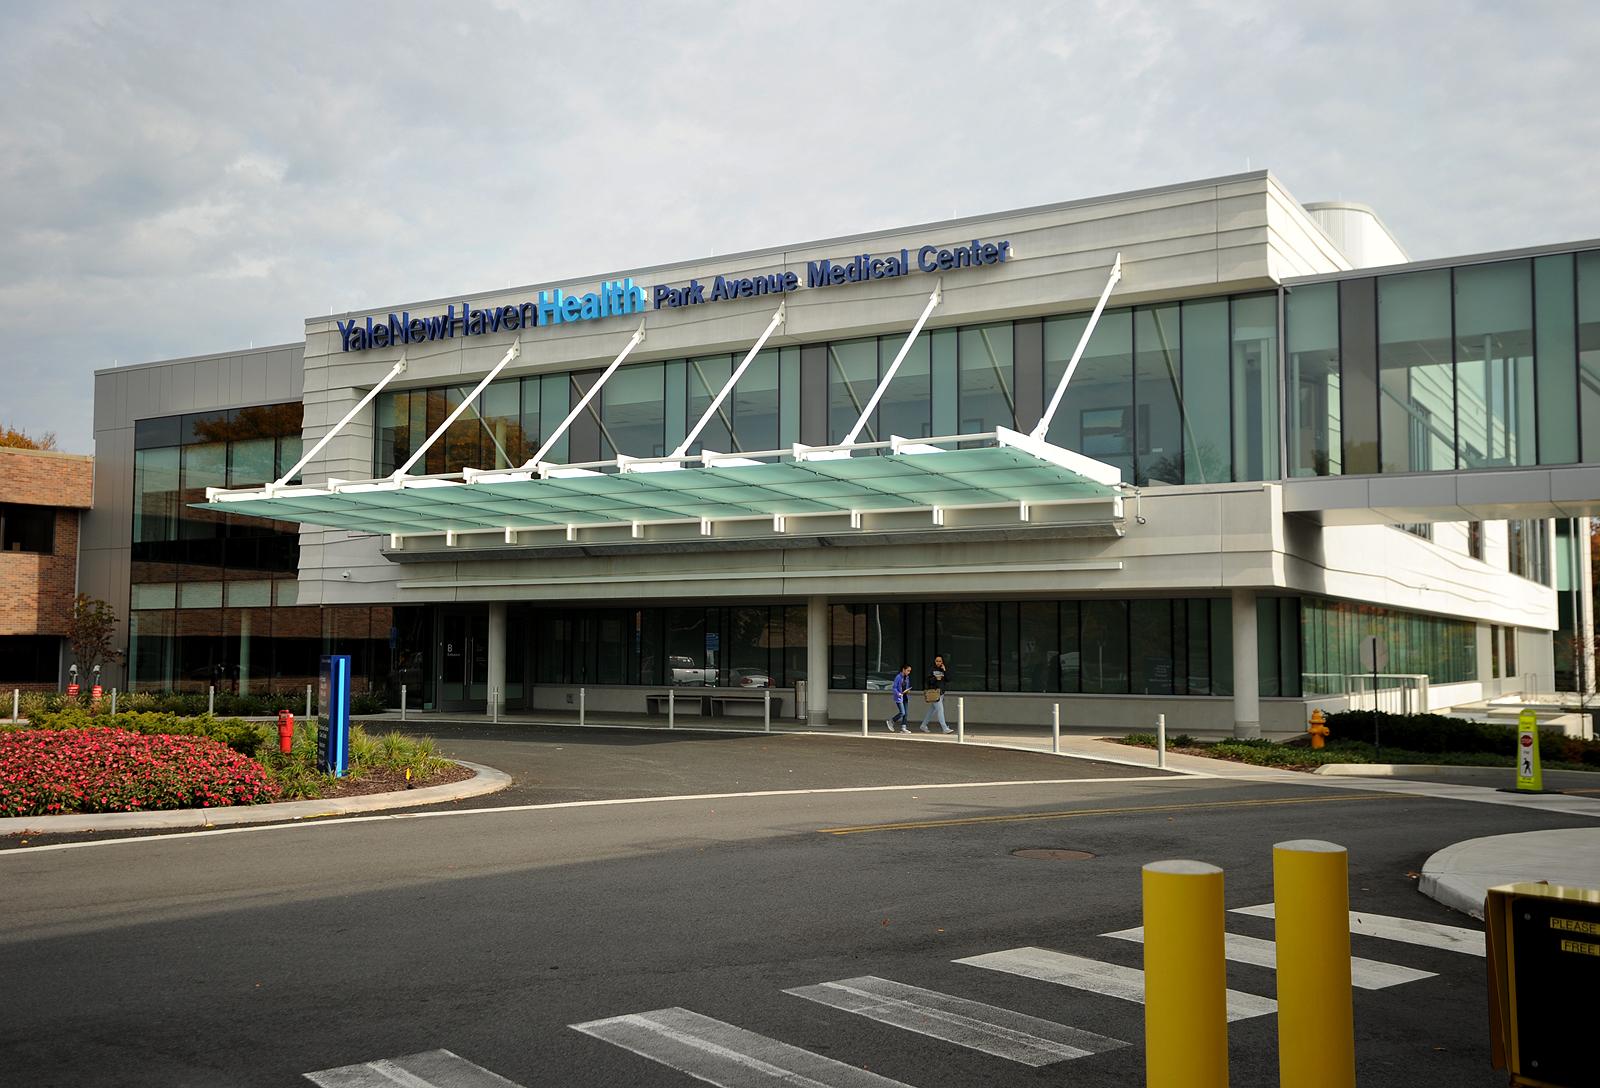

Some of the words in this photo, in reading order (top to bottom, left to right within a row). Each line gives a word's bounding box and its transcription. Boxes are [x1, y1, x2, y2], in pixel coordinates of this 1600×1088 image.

[653, 279, 705, 309] Park
[710, 269, 799, 302] Avenue
[807, 248, 909, 288] Medical
[917, 239, 1010, 273] Center
[1552, 918, 1596, 934] PLEASE
[1564, 940, 1595, 955] FREE
